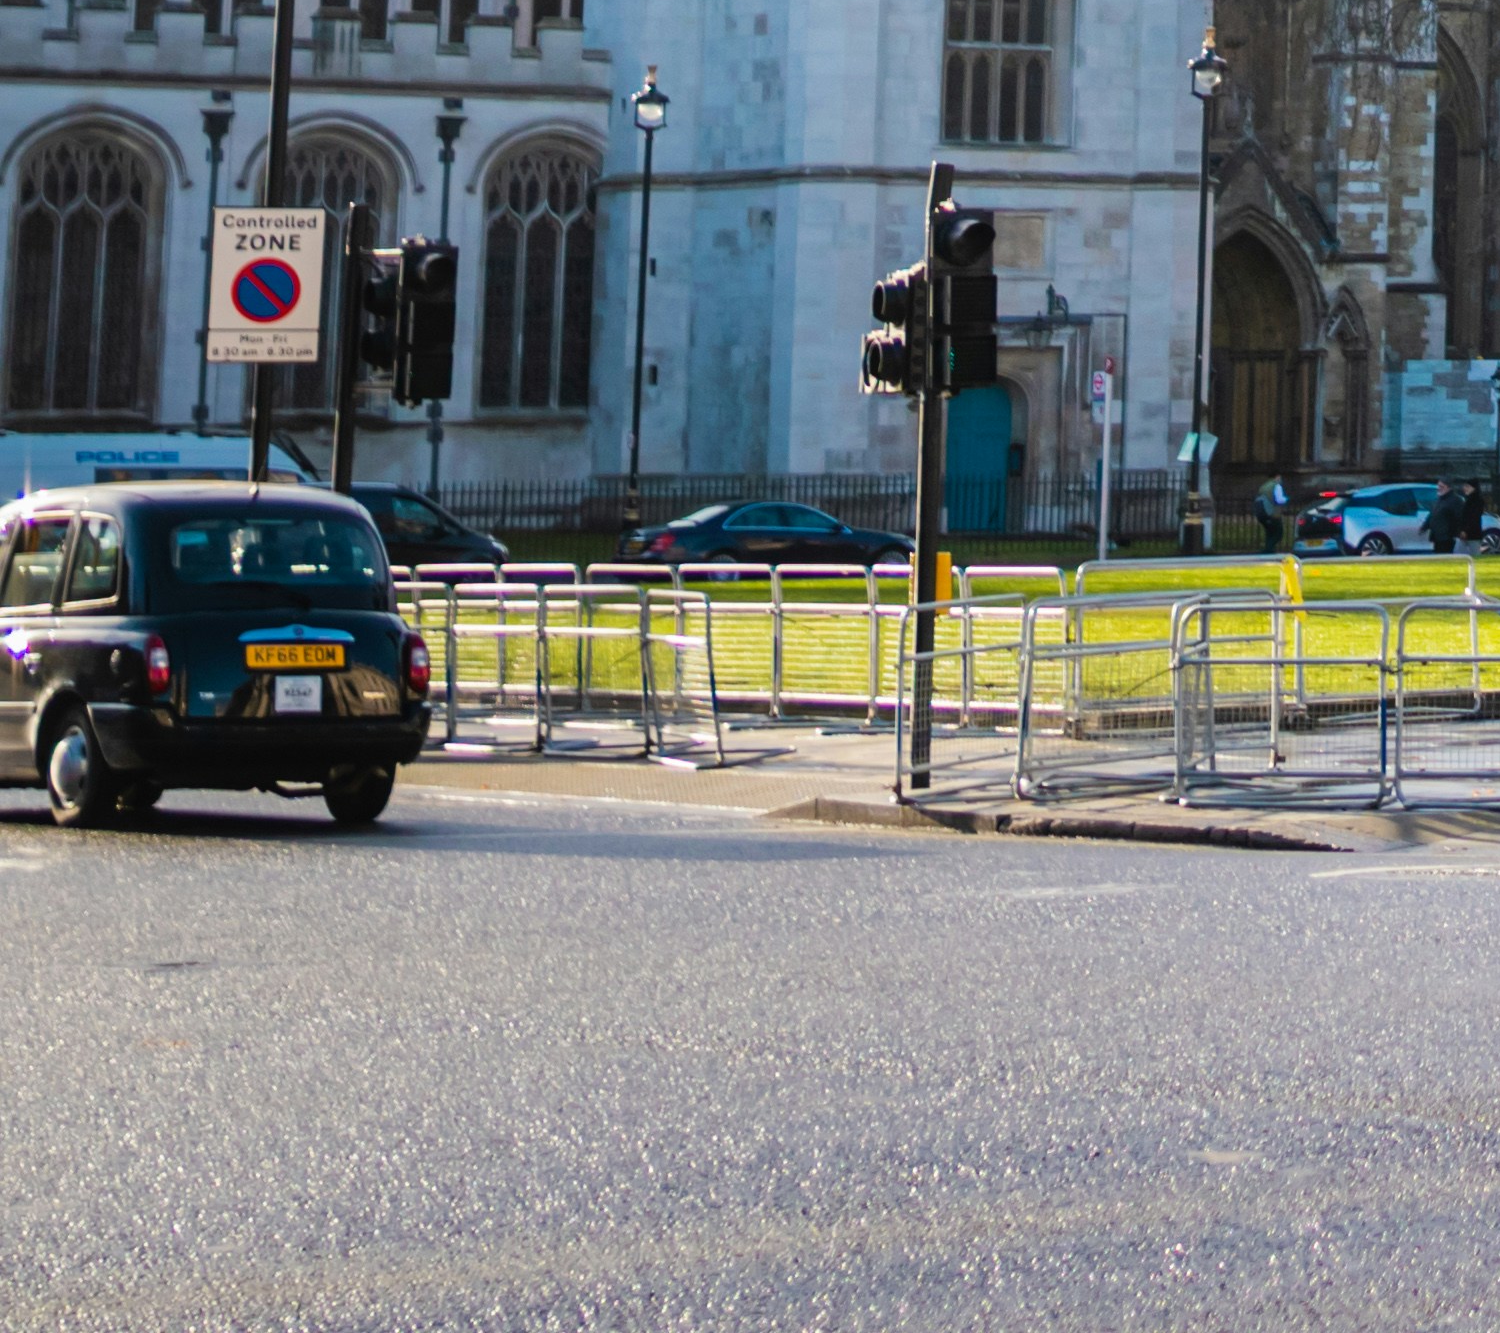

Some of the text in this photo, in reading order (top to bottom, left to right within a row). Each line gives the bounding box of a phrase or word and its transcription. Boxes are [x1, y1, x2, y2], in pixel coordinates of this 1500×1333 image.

[222, 214, 318, 229] Controlled
[235, 234, 302, 250] ZONE
[239, 334, 288, 343] Mon Fri
[76, 451, 179, 463] POLICE
[254, 646, 299, 663] KF66
